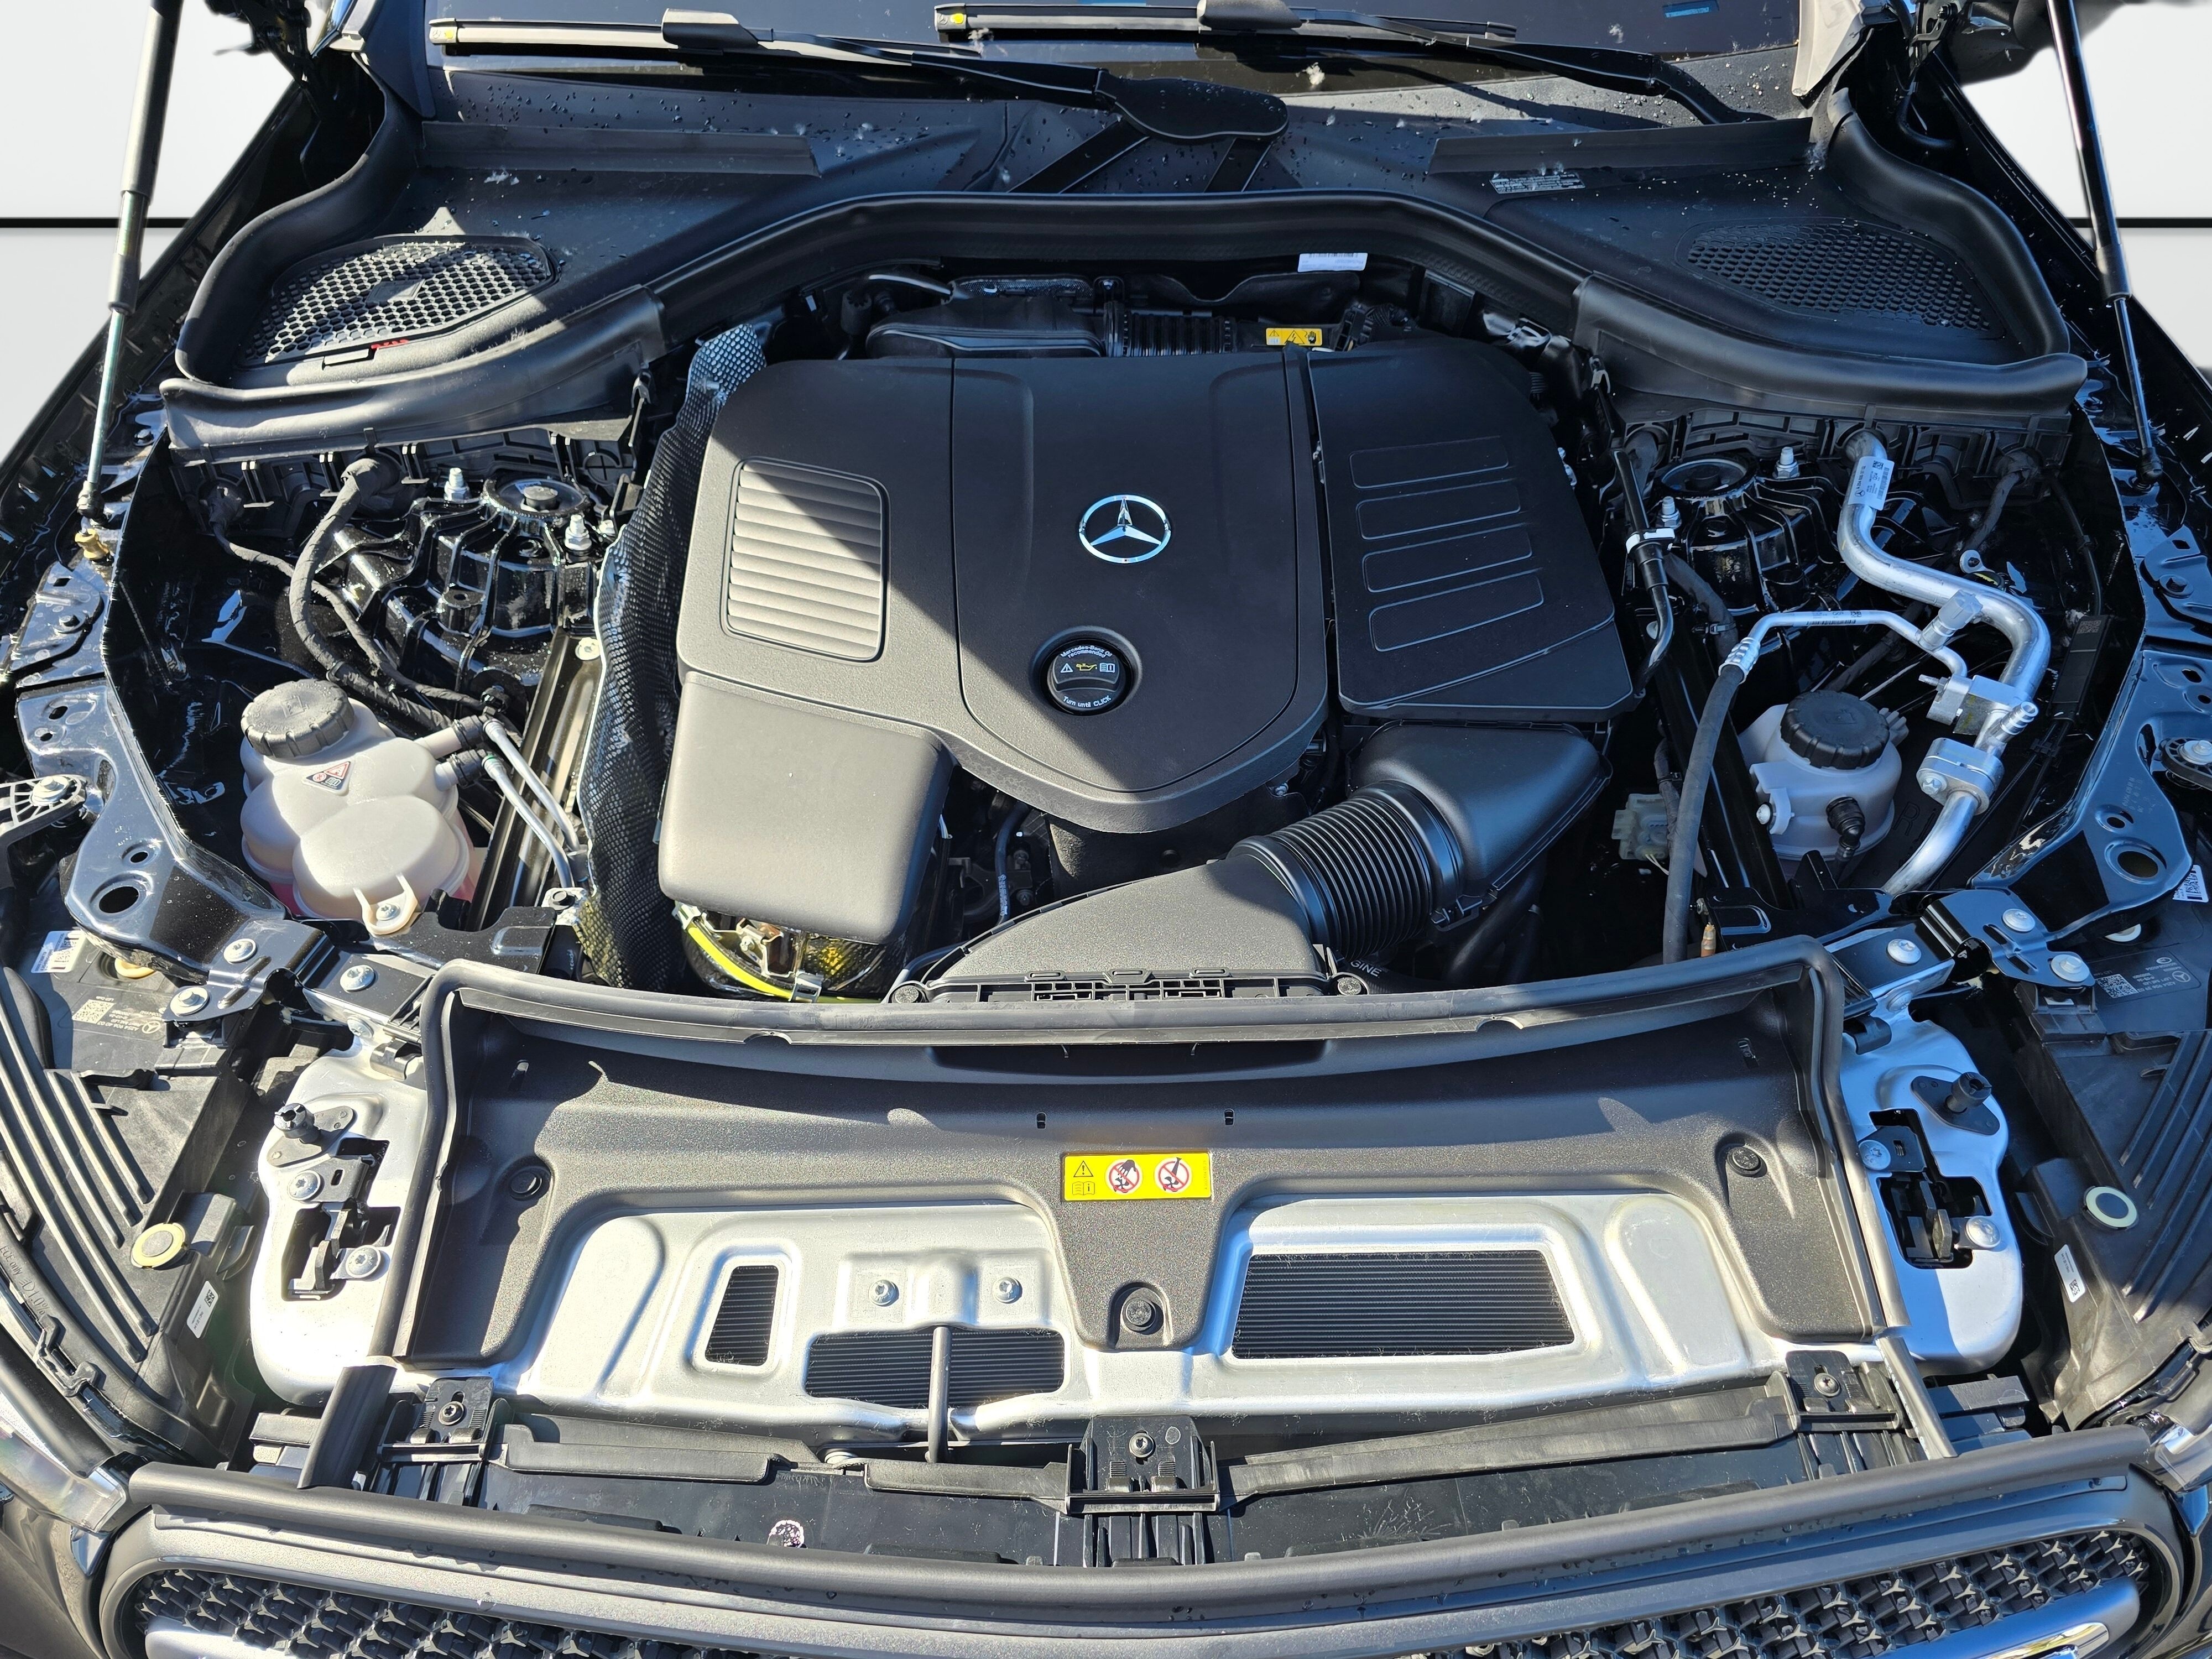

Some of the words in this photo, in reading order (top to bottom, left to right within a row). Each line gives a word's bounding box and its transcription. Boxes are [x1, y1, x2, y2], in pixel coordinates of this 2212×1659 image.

[1060, 645, 1105, 658] Mercedes-Benz
[1068, 649, 1106, 658] recommended
[1063, 696, 1076, 706] Turn
[1093, 695, 1112, 707] CLICK
[0, 1245, 15, 1262] ECE
[9, 1261, 23, 1276] only
[28, 1291, 50, 1316] 1.0%
